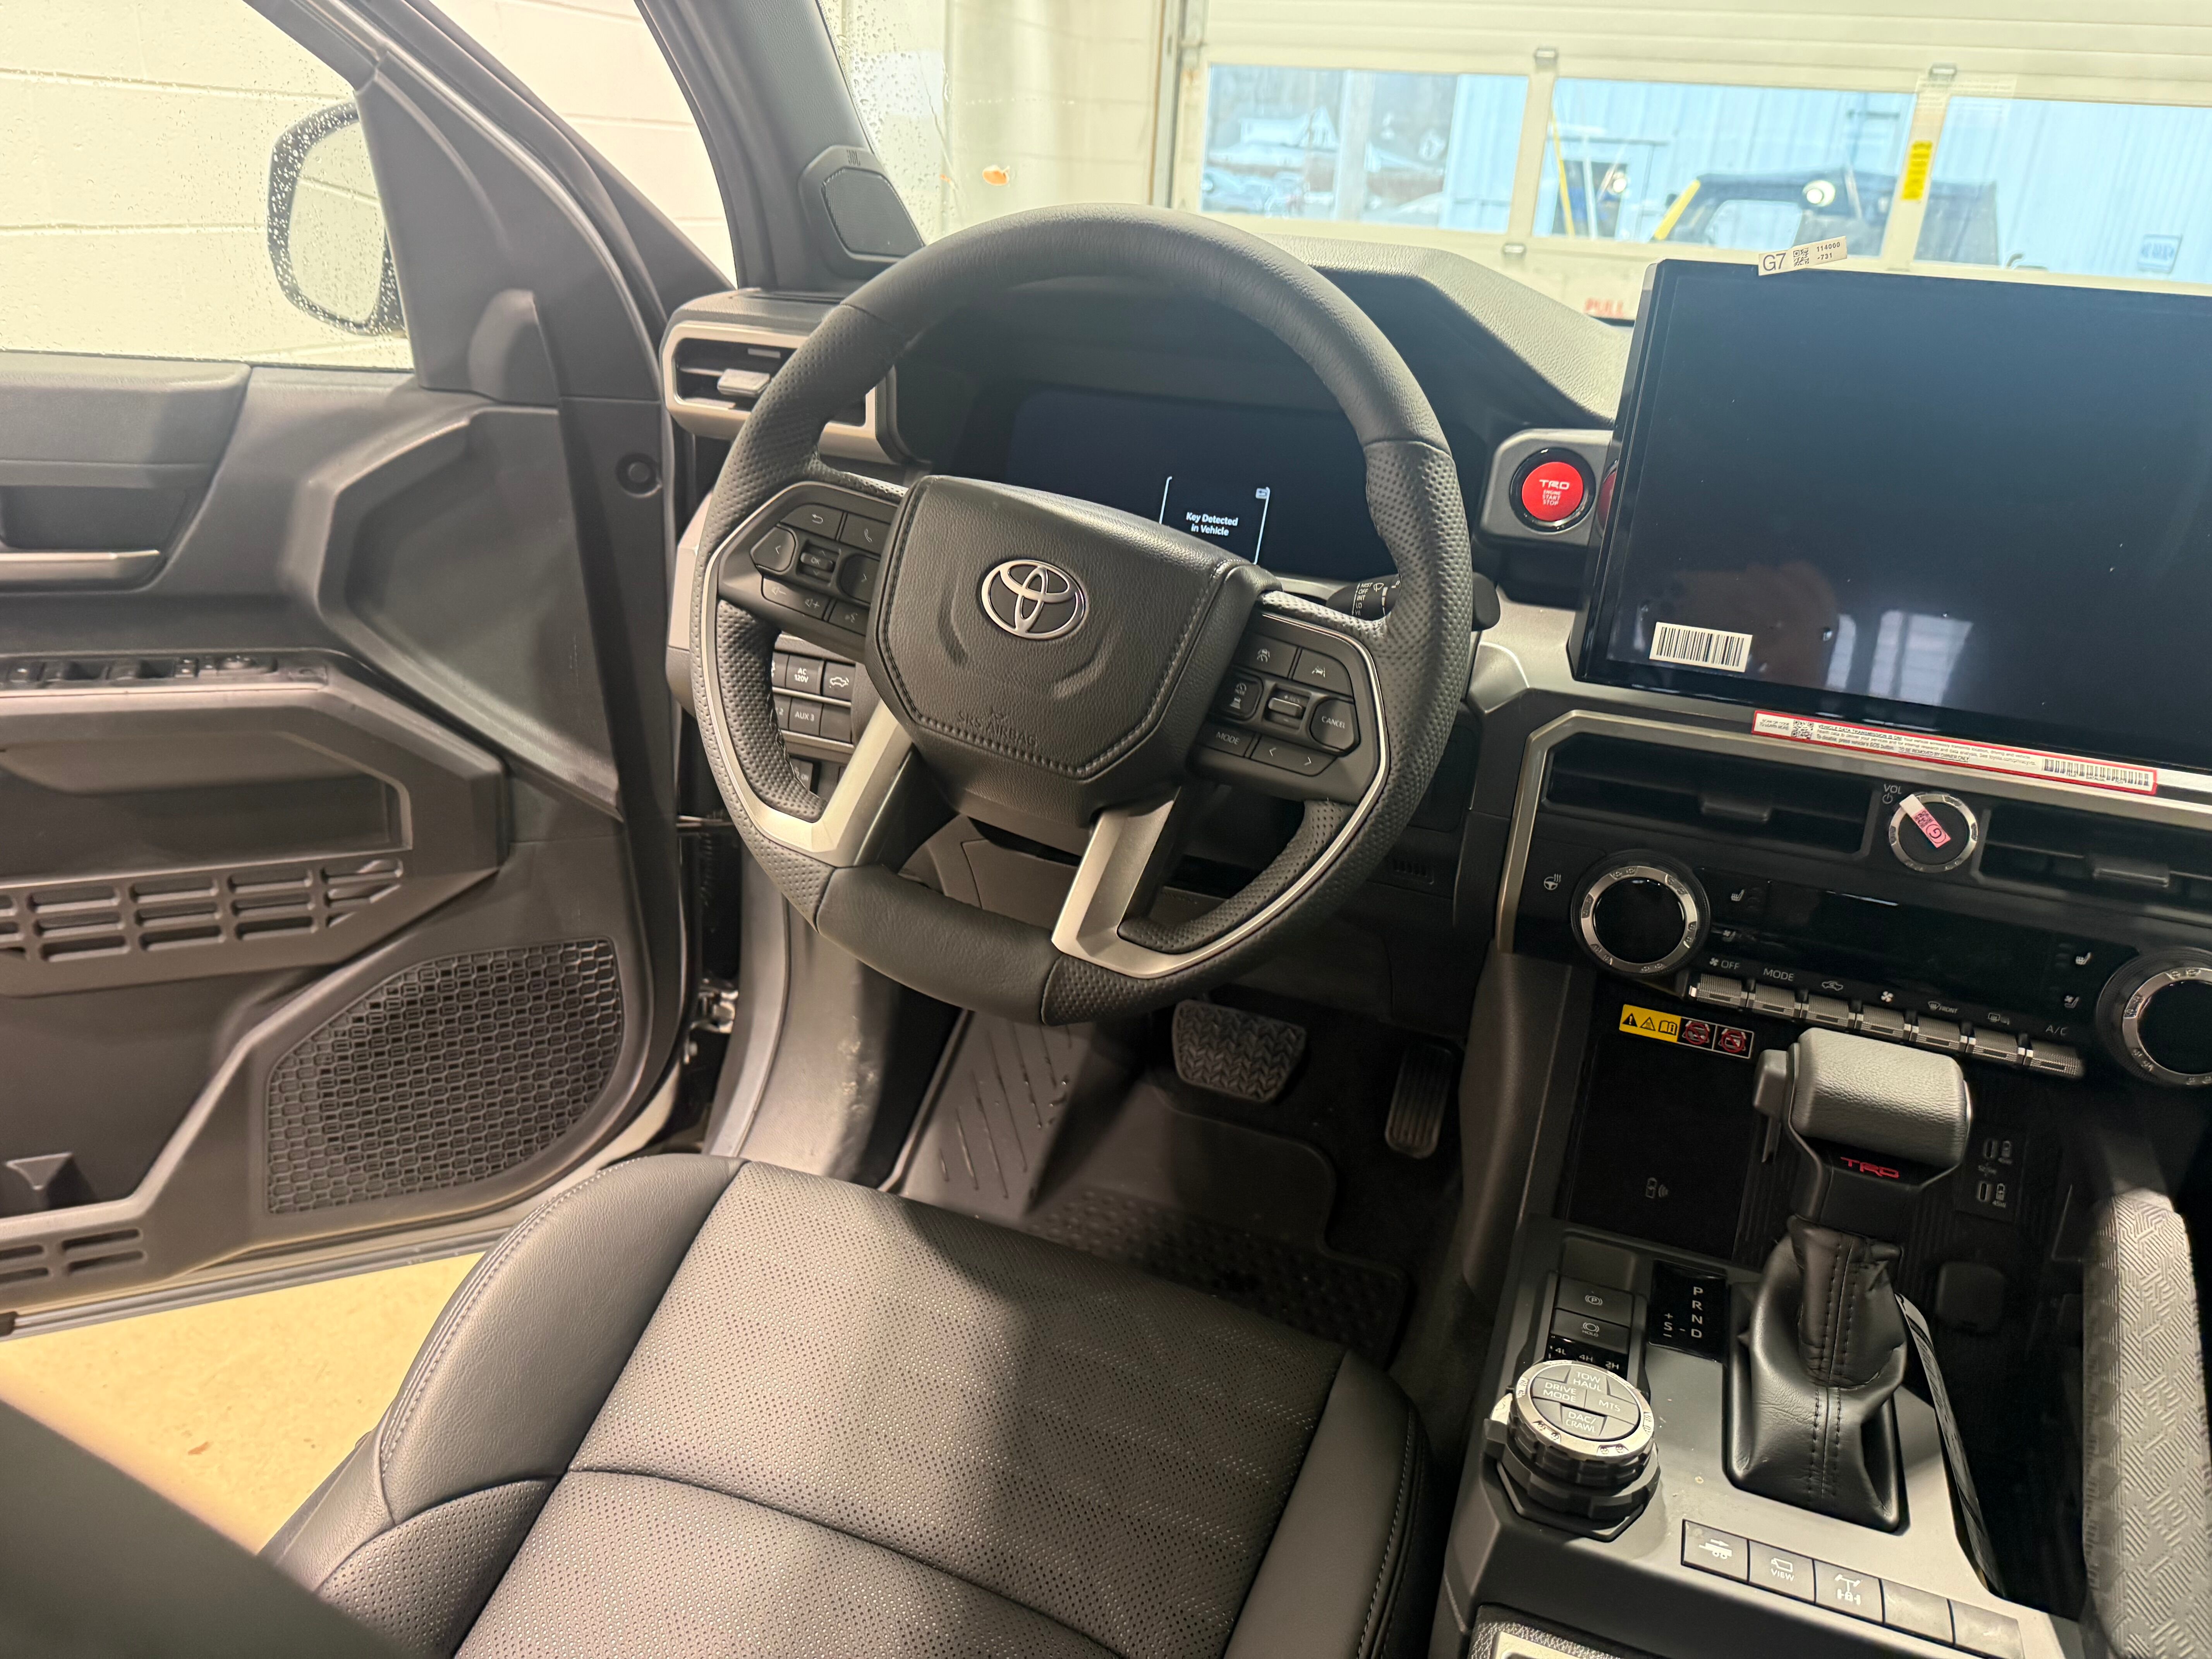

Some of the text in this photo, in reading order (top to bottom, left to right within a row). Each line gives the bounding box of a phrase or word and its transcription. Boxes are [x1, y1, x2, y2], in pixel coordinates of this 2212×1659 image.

[1817, 242, 1840, 252] 114000
[1763, 252, 1786, 271] G7
[1539, 479, 1570, 490] TRD
[1186, 512, 1238, 526] Key Detected
[1191, 524, 1229, 536] in Vehicle
[797, 667, 807, 675] AC
[794, 673, 809, 684] 120V
[795, 711, 815, 721] AUX 3
[1321, 715, 1345, 729] CANCEL
[1216, 731, 1240, 745] MODE
[1883, 783, 1902, 794] VOL
[1721, 960, 1741, 970] OFF
[1763, 968, 1795, 981] MODE
[2045, 1024, 2069, 1036] A/C
[1840, 1156, 1900, 1179] TRD
[1693, 1286, 1704, 1296] P
[1692, 1300, 1704, 1311] R
[1692, 1314, 1703, 1325] N
[1664, 1321, 1702, 1338] S D
[1555, 1347, 1567, 1355] 4L
[1579, 1354, 1594, 1363] 4H
[1605, 1361, 1620, 1370] 2H
[1577, 1371, 1601, 1383] TOW
[1545, 1382, 1577, 1395] DRIVE
[1573, 1378, 1602, 1392] HAUL
[1543, 1389, 1577, 1403] MODE
[1599, 1399, 1621, 1412] MTS
[1568, 1411, 1597, 1425] DAC/
[1565, 1419, 1596, 1433] CRAWL
[1771, 1568, 1795, 1582] VIEW
